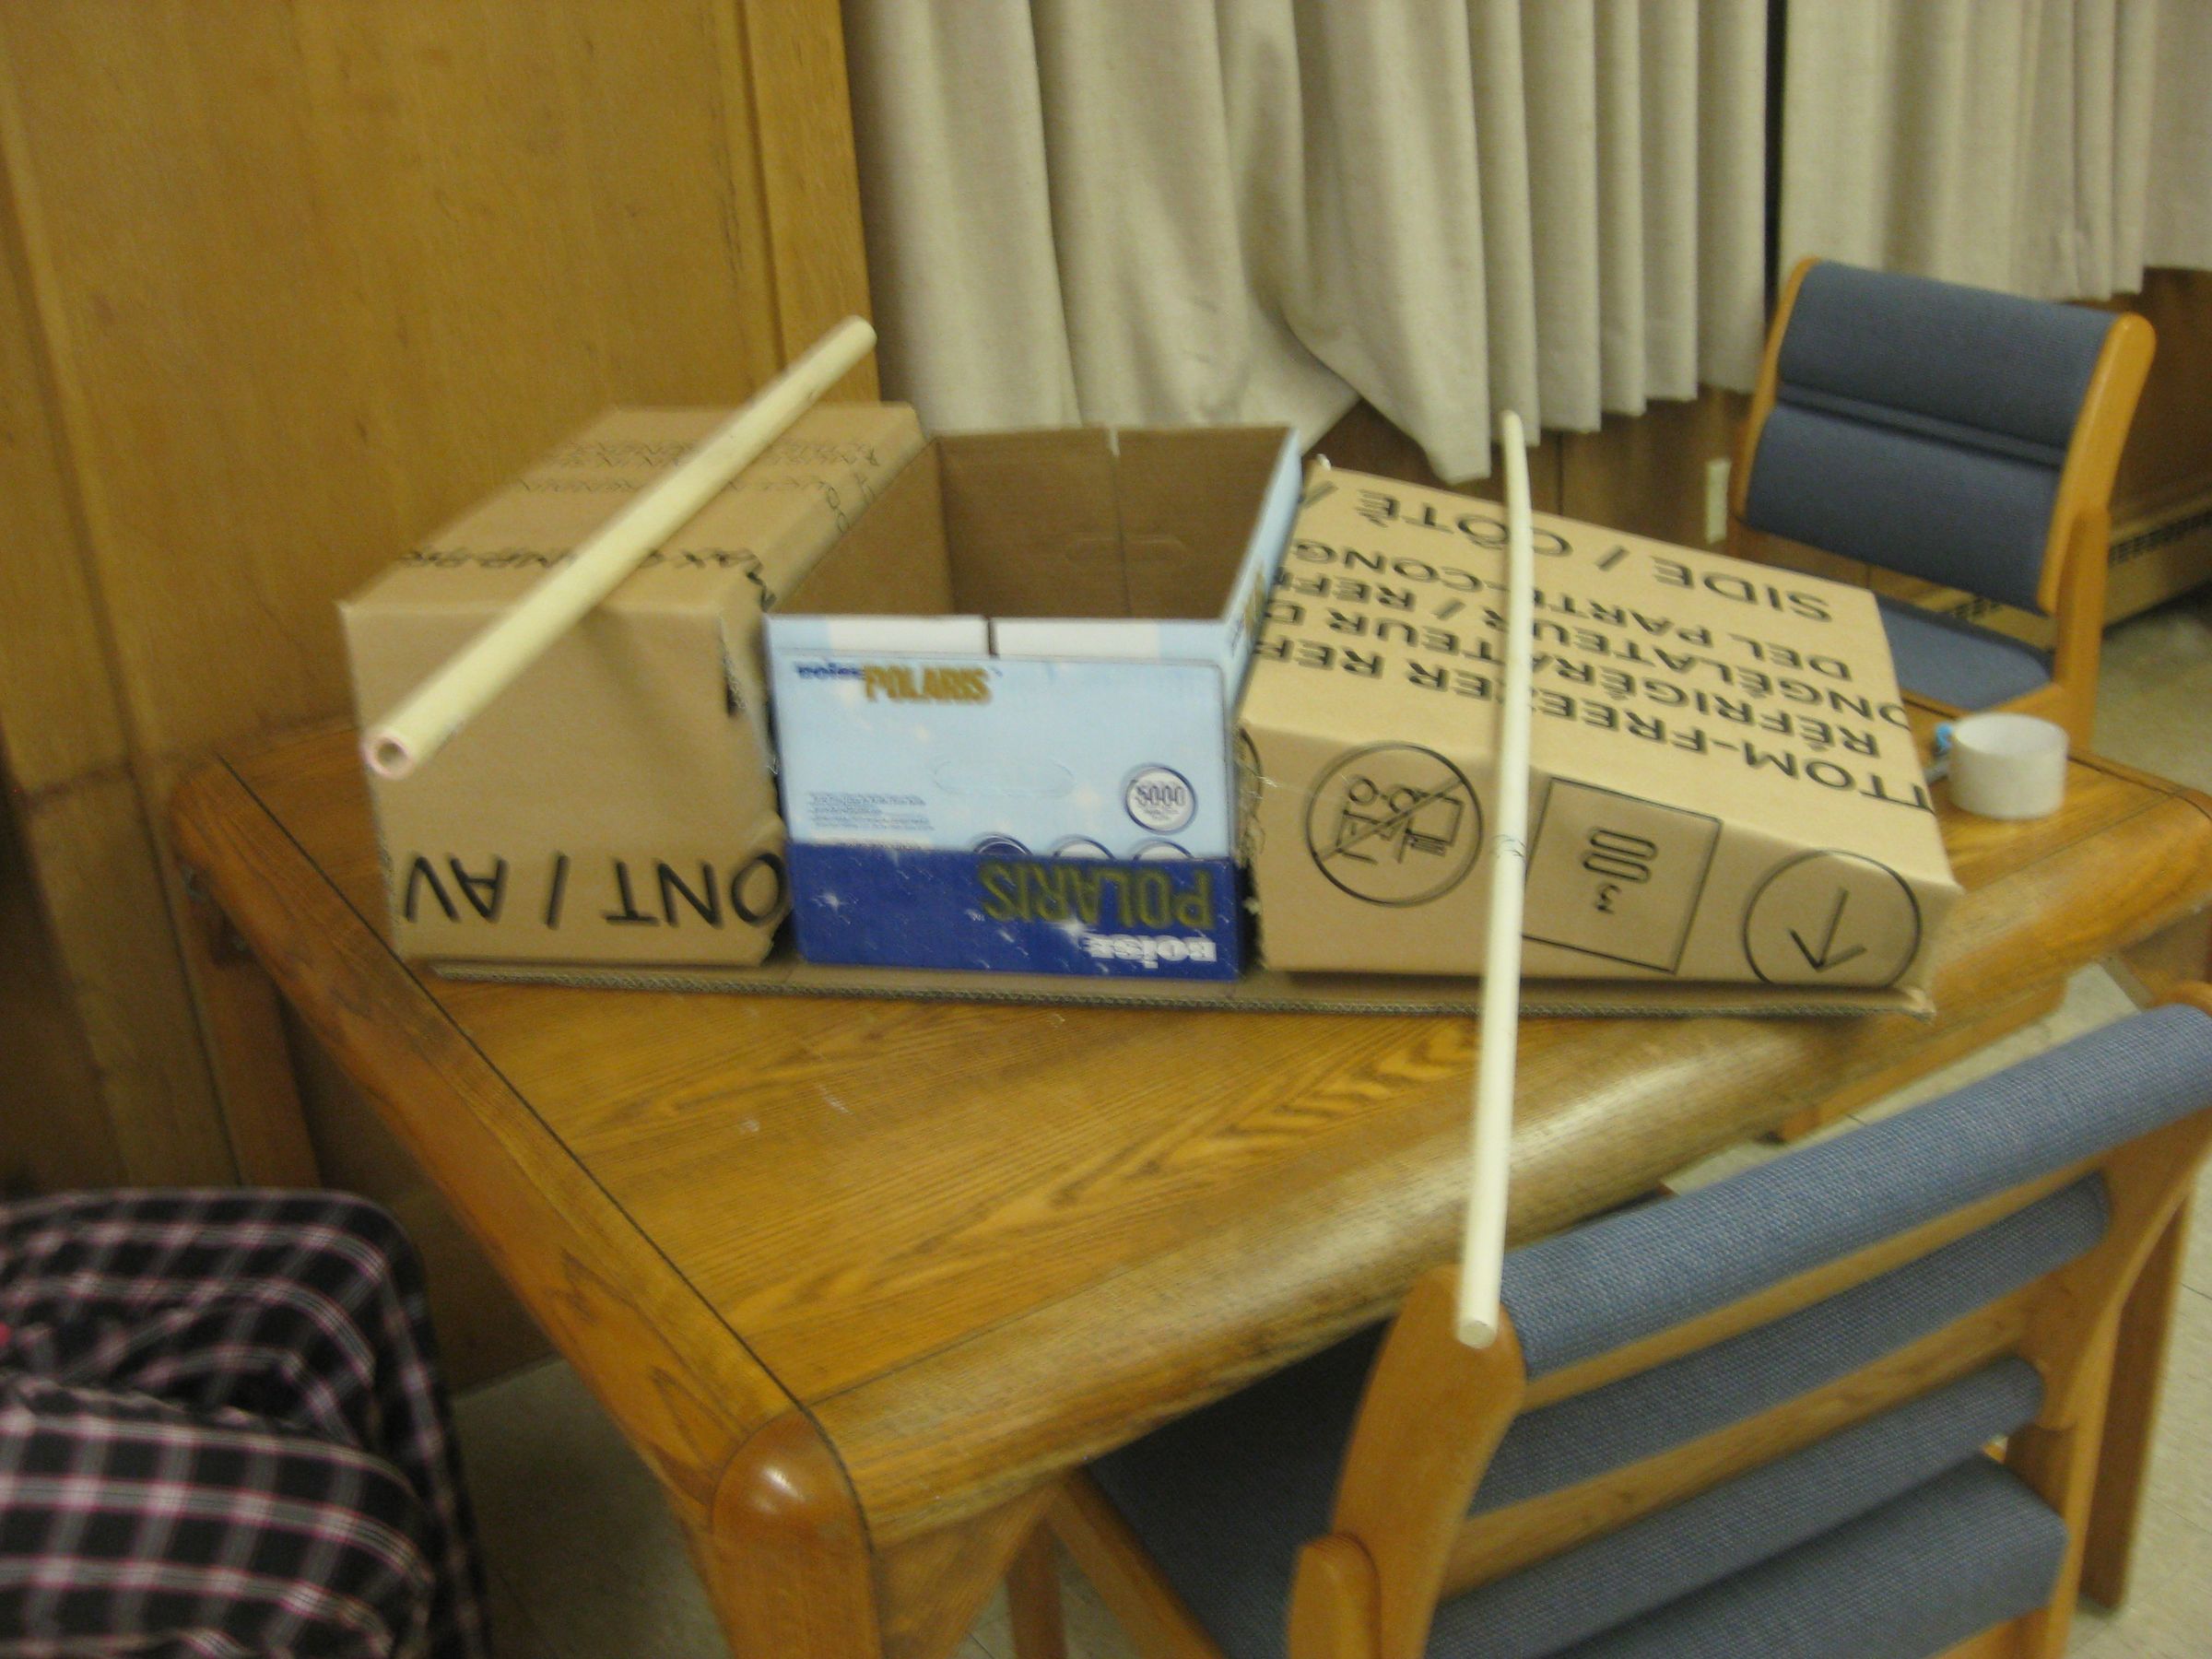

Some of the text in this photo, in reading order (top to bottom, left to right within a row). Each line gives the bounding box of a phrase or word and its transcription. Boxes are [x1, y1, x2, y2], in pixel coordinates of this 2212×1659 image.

[1652, 556, 1832, 622] SIDE
[1728, 632, 1853, 682] DEL
[403, 854, 511, 925] AV
[604, 852, 785, 931] ONT
[979, 860, 1215, 931] POLARIS
